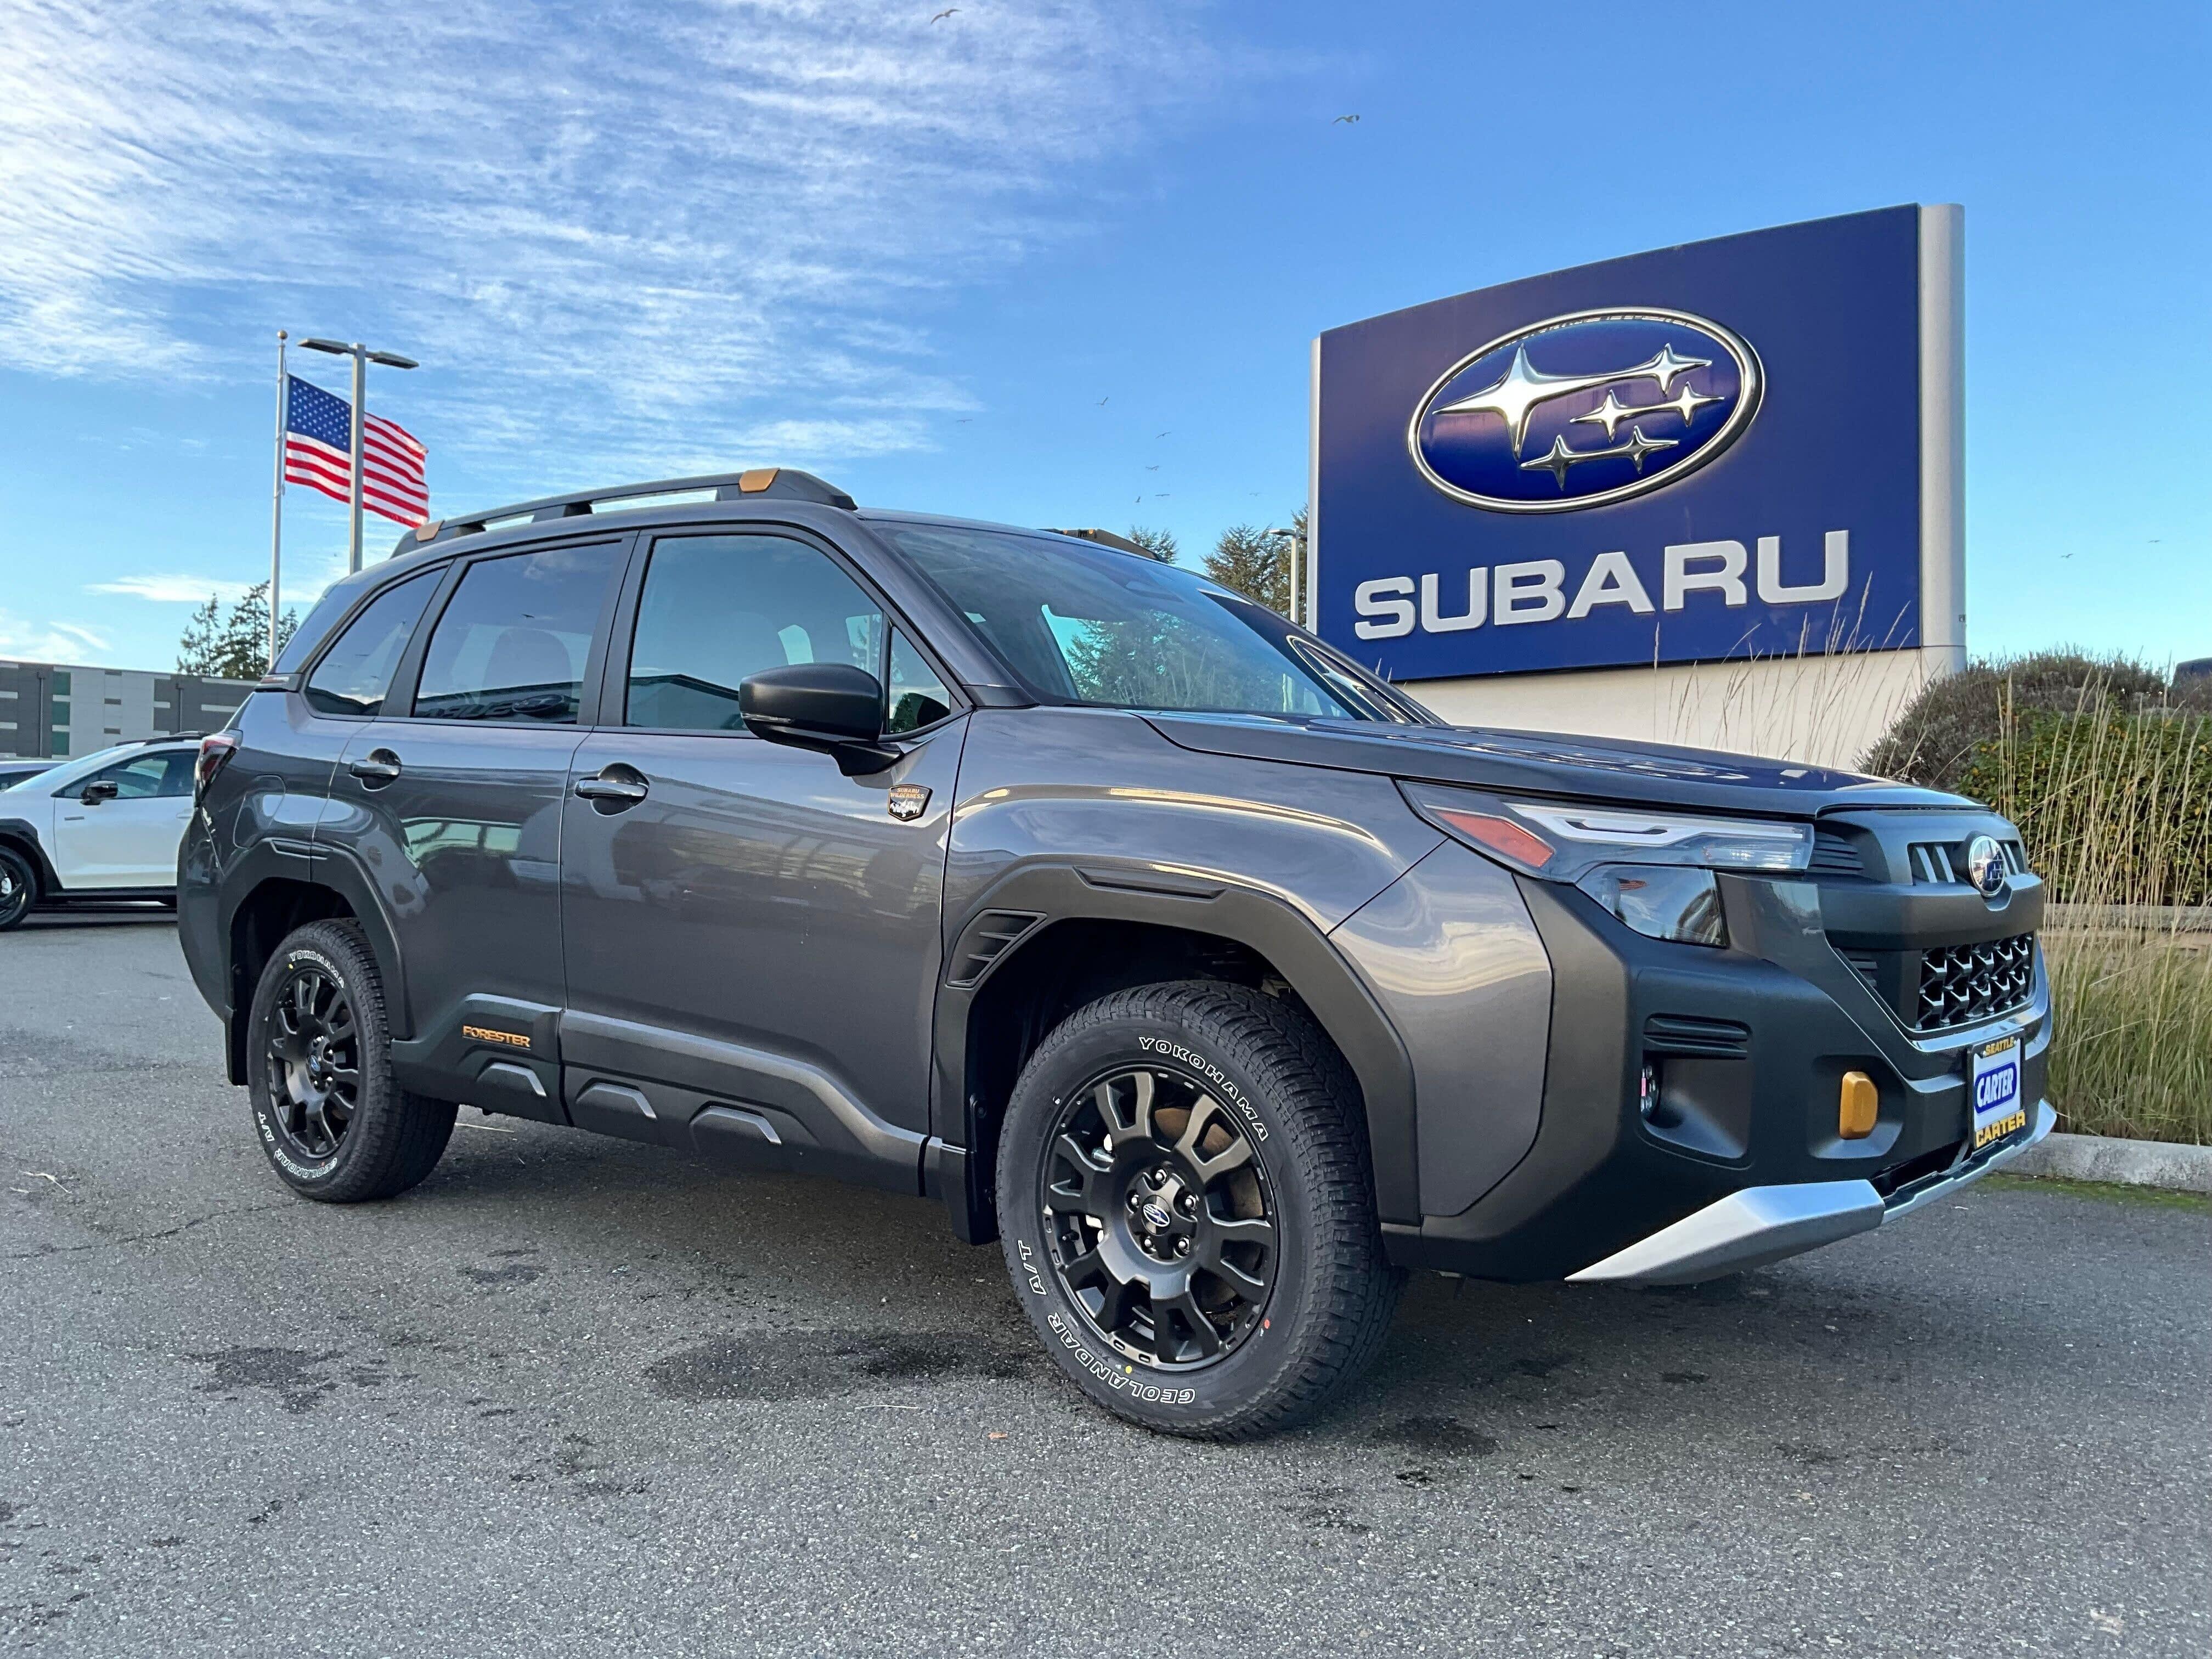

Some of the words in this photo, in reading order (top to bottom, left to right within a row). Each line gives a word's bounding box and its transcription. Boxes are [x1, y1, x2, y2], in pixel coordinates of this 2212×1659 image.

[1354, 529, 1849, 640] SUBARU
[289, 950, 345, 989] YOKOHAMA
[462, 1025, 531, 1047] FORESTER
[1985, 1036, 2014, 1056] SEATTLE
[1138, 1036, 1269, 1142] YOKOHAMA
[1977, 1068, 2014, 1108] CARTER
[258, 1111, 275, 1142] A/T
[1976, 1110, 2025, 1148] CARTER
[274, 1148, 337, 1178] GEOLANDAR
[1017, 1239, 1047, 1295] A/T
[1047, 1312, 1196, 1404] GEOLANDAR
